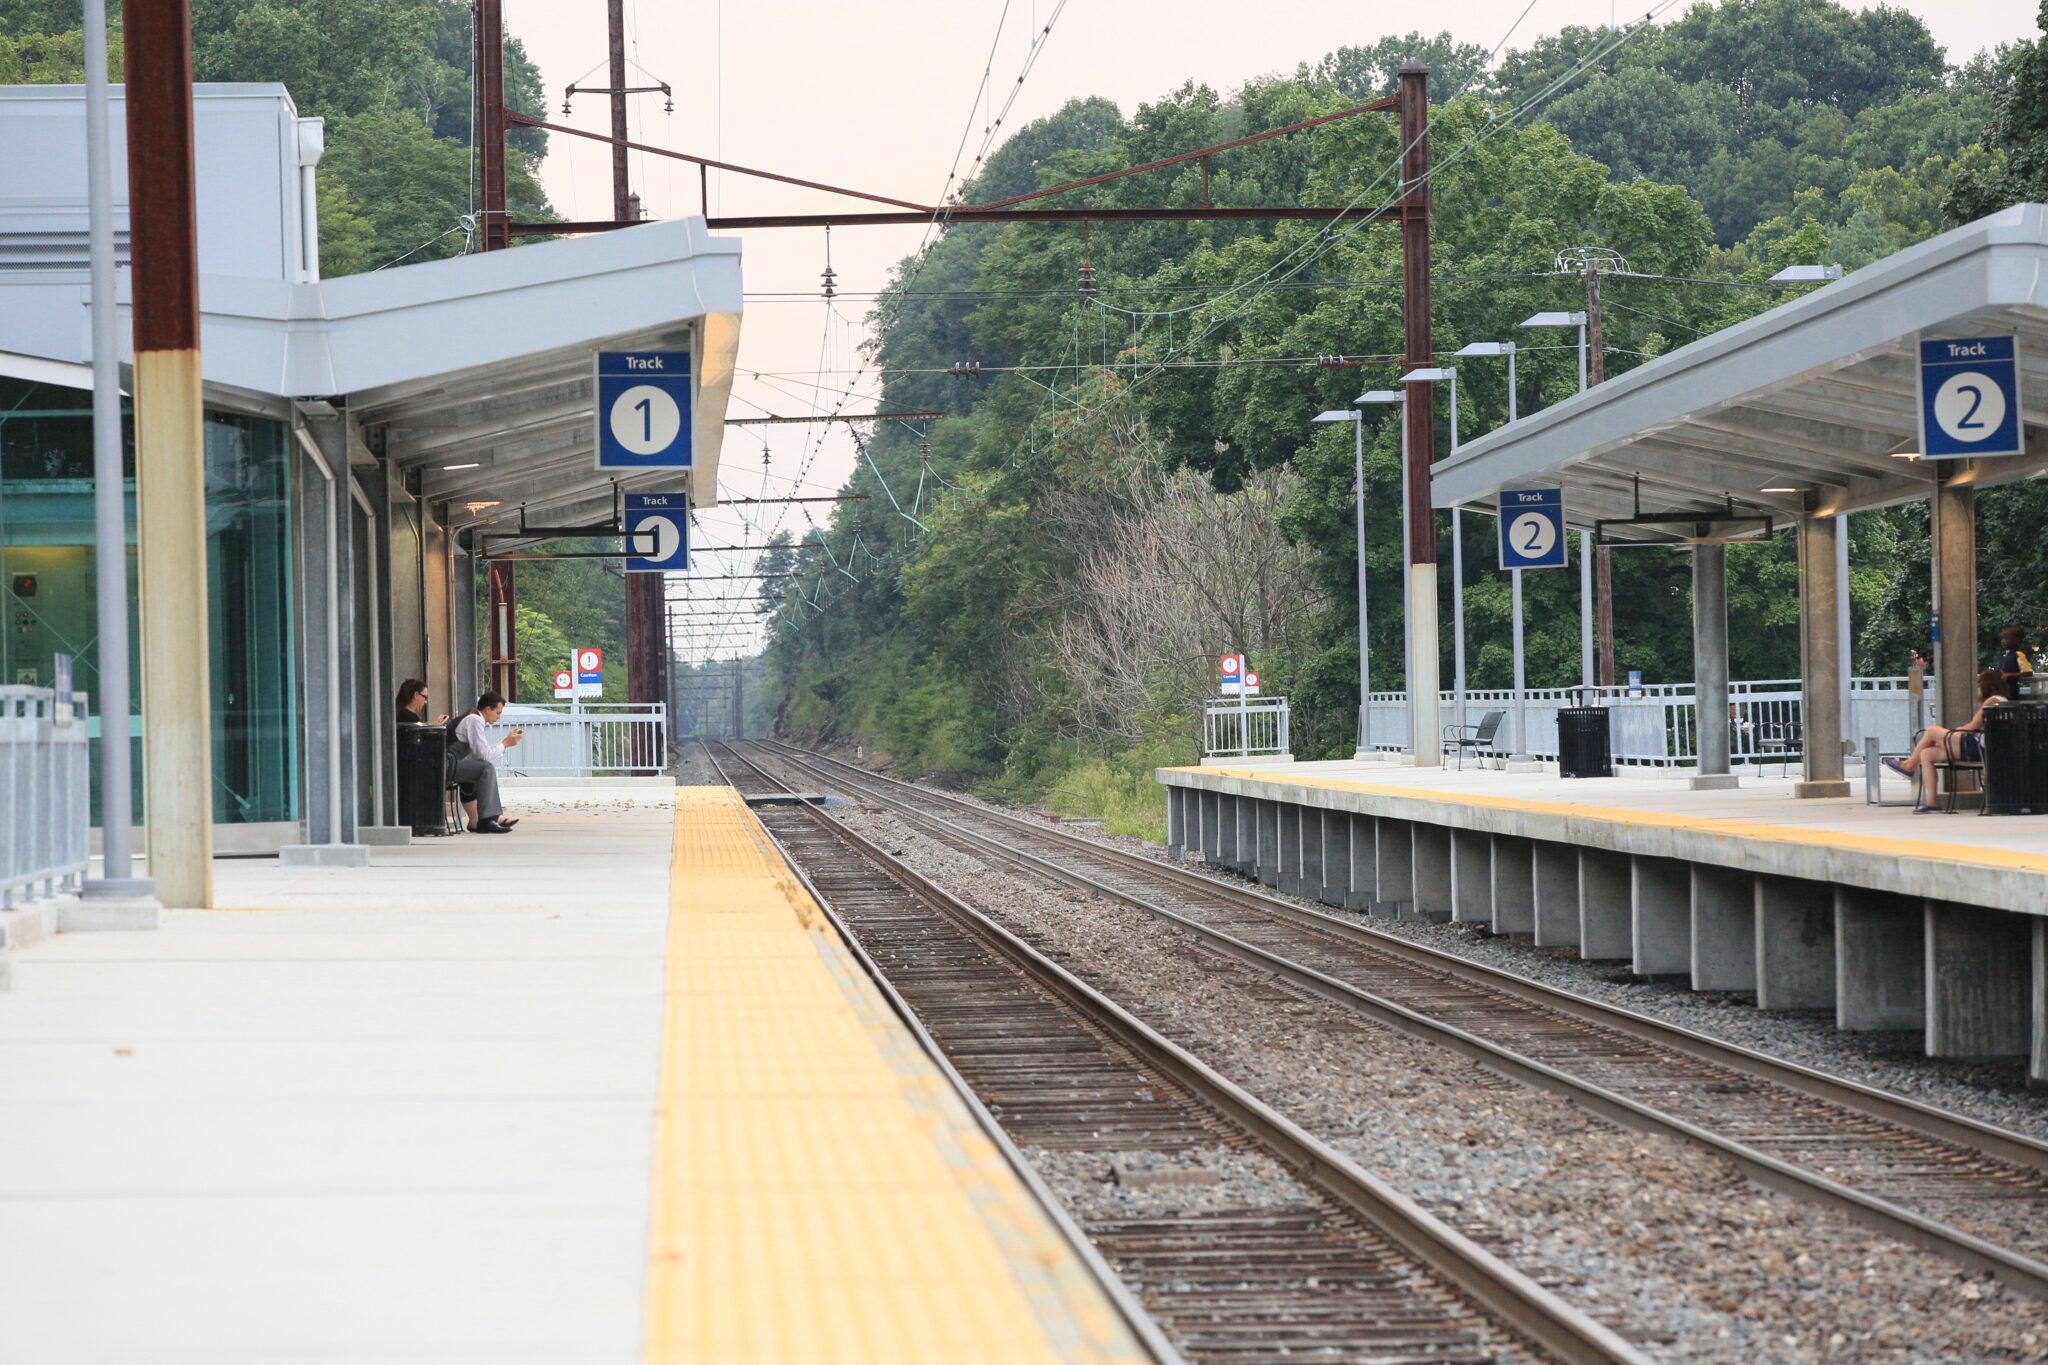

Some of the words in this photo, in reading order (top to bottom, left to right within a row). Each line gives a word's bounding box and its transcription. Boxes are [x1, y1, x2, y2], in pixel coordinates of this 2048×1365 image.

[1947, 342, 1987, 357] Track
[625, 356, 664, 369] Track
[1957, 385, 1984, 429] 2
[634, 398, 651, 442] 1
[642, 496, 668, 505] Track
[1517, 492, 1544, 502] Track
[648, 524, 660, 553] 1
[1523, 521, 1542, 550] 2
